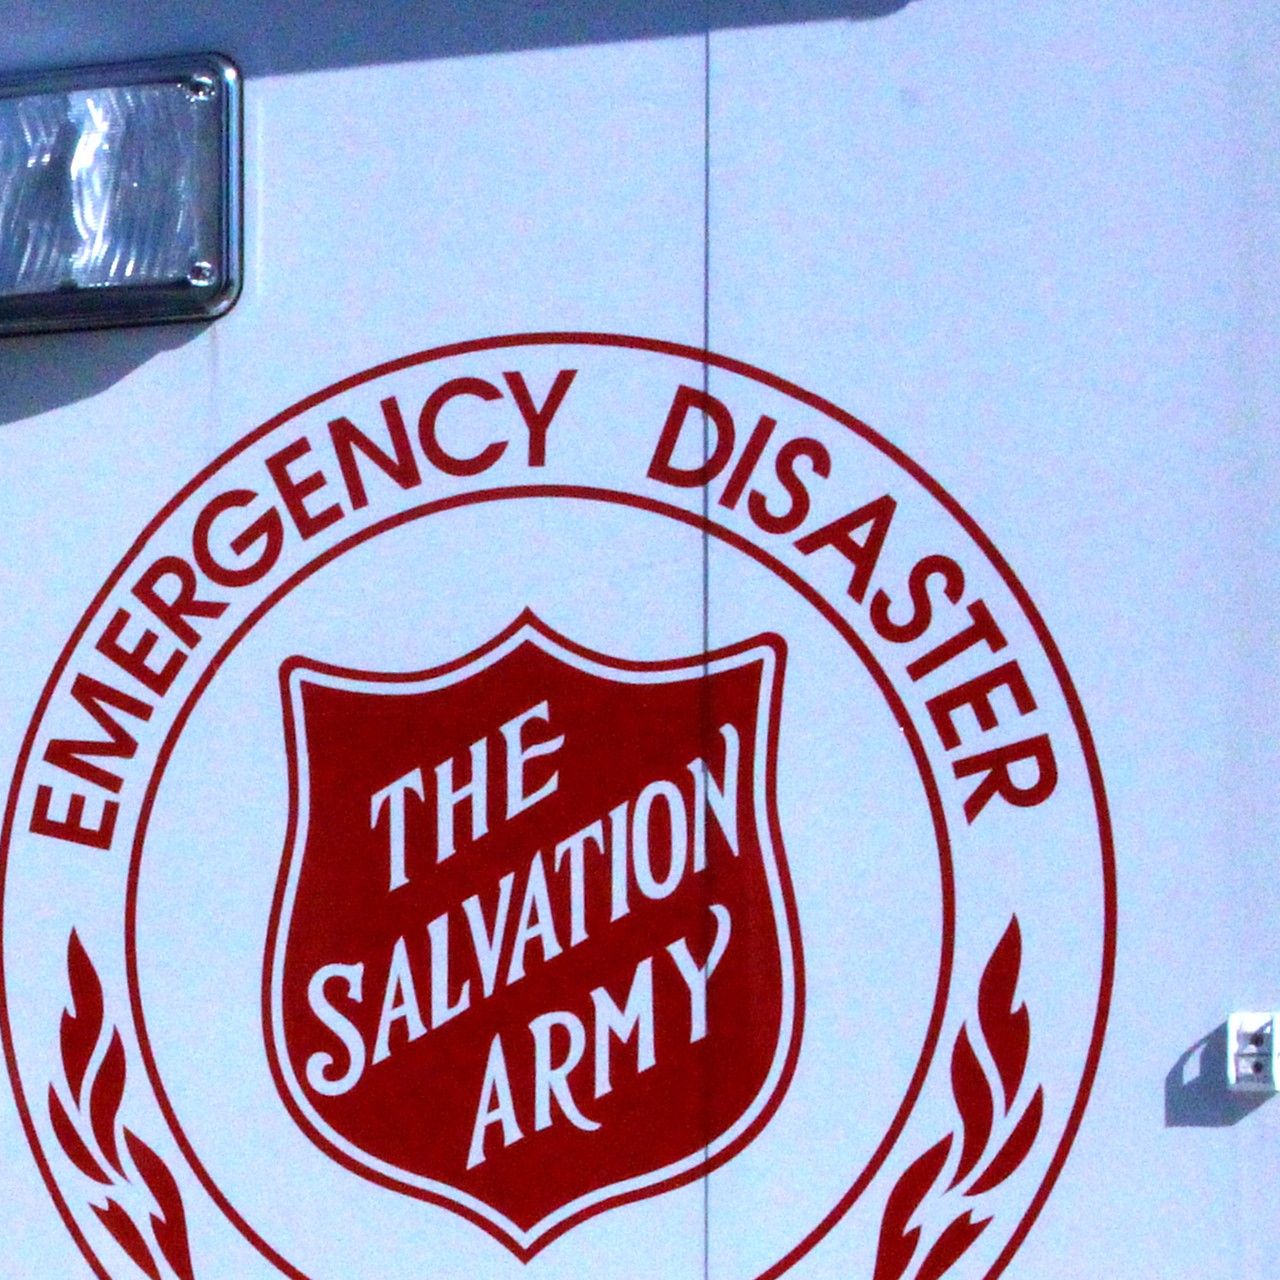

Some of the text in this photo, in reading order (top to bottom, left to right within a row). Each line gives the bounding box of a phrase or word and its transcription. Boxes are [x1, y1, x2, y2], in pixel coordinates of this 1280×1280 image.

[30, 369, 1058, 851] EMERGENCY DISASTER
[305, 722, 741, 1096] SALVATION
[370, 701, 565, 891] THE
[467, 903, 732, 1169] ARMY
